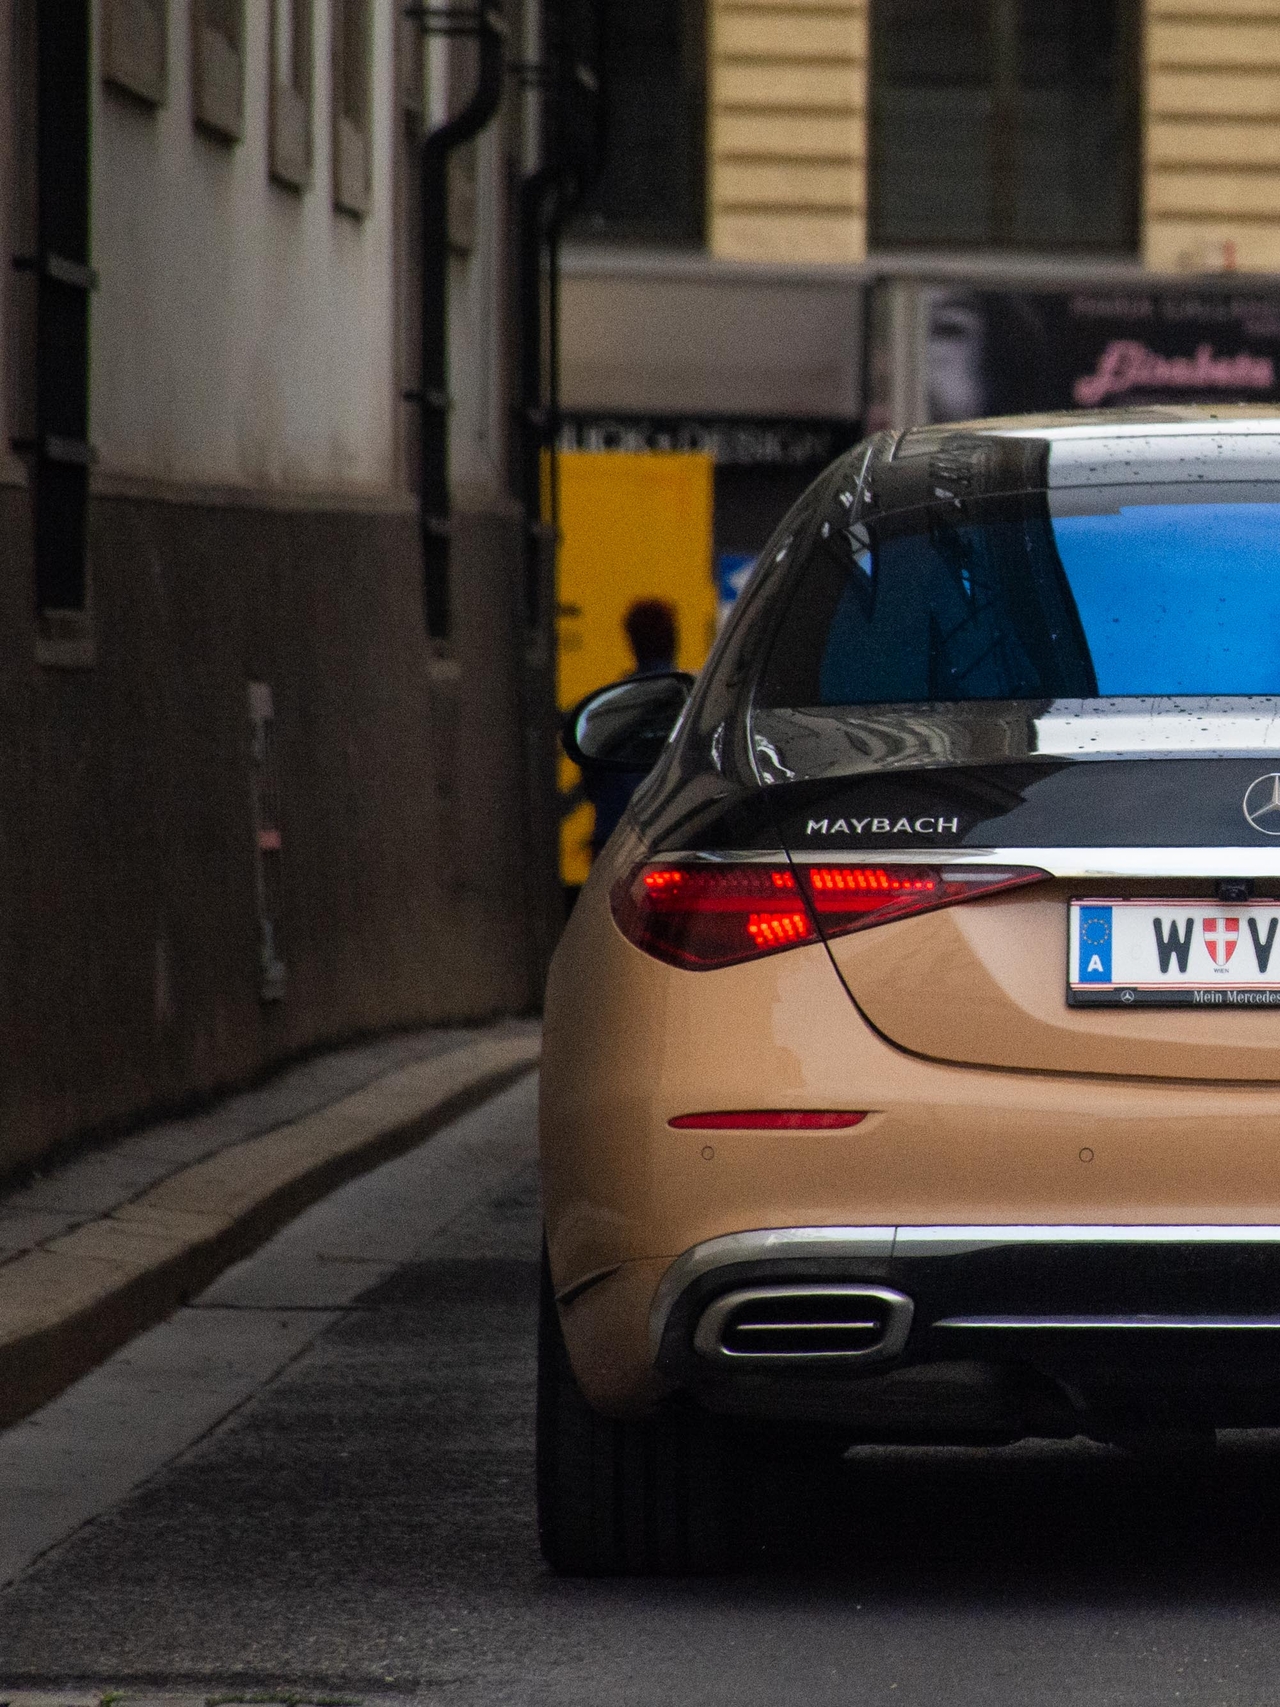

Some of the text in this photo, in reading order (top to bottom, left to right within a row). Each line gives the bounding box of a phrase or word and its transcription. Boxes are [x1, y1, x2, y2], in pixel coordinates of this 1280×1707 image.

[806, 817, 958, 835] MAYBACH
[1153, 917, 1195, 974] W
[1087, 954, 1104, 972] A
[1193, 990, 1222, 1004] Mein
